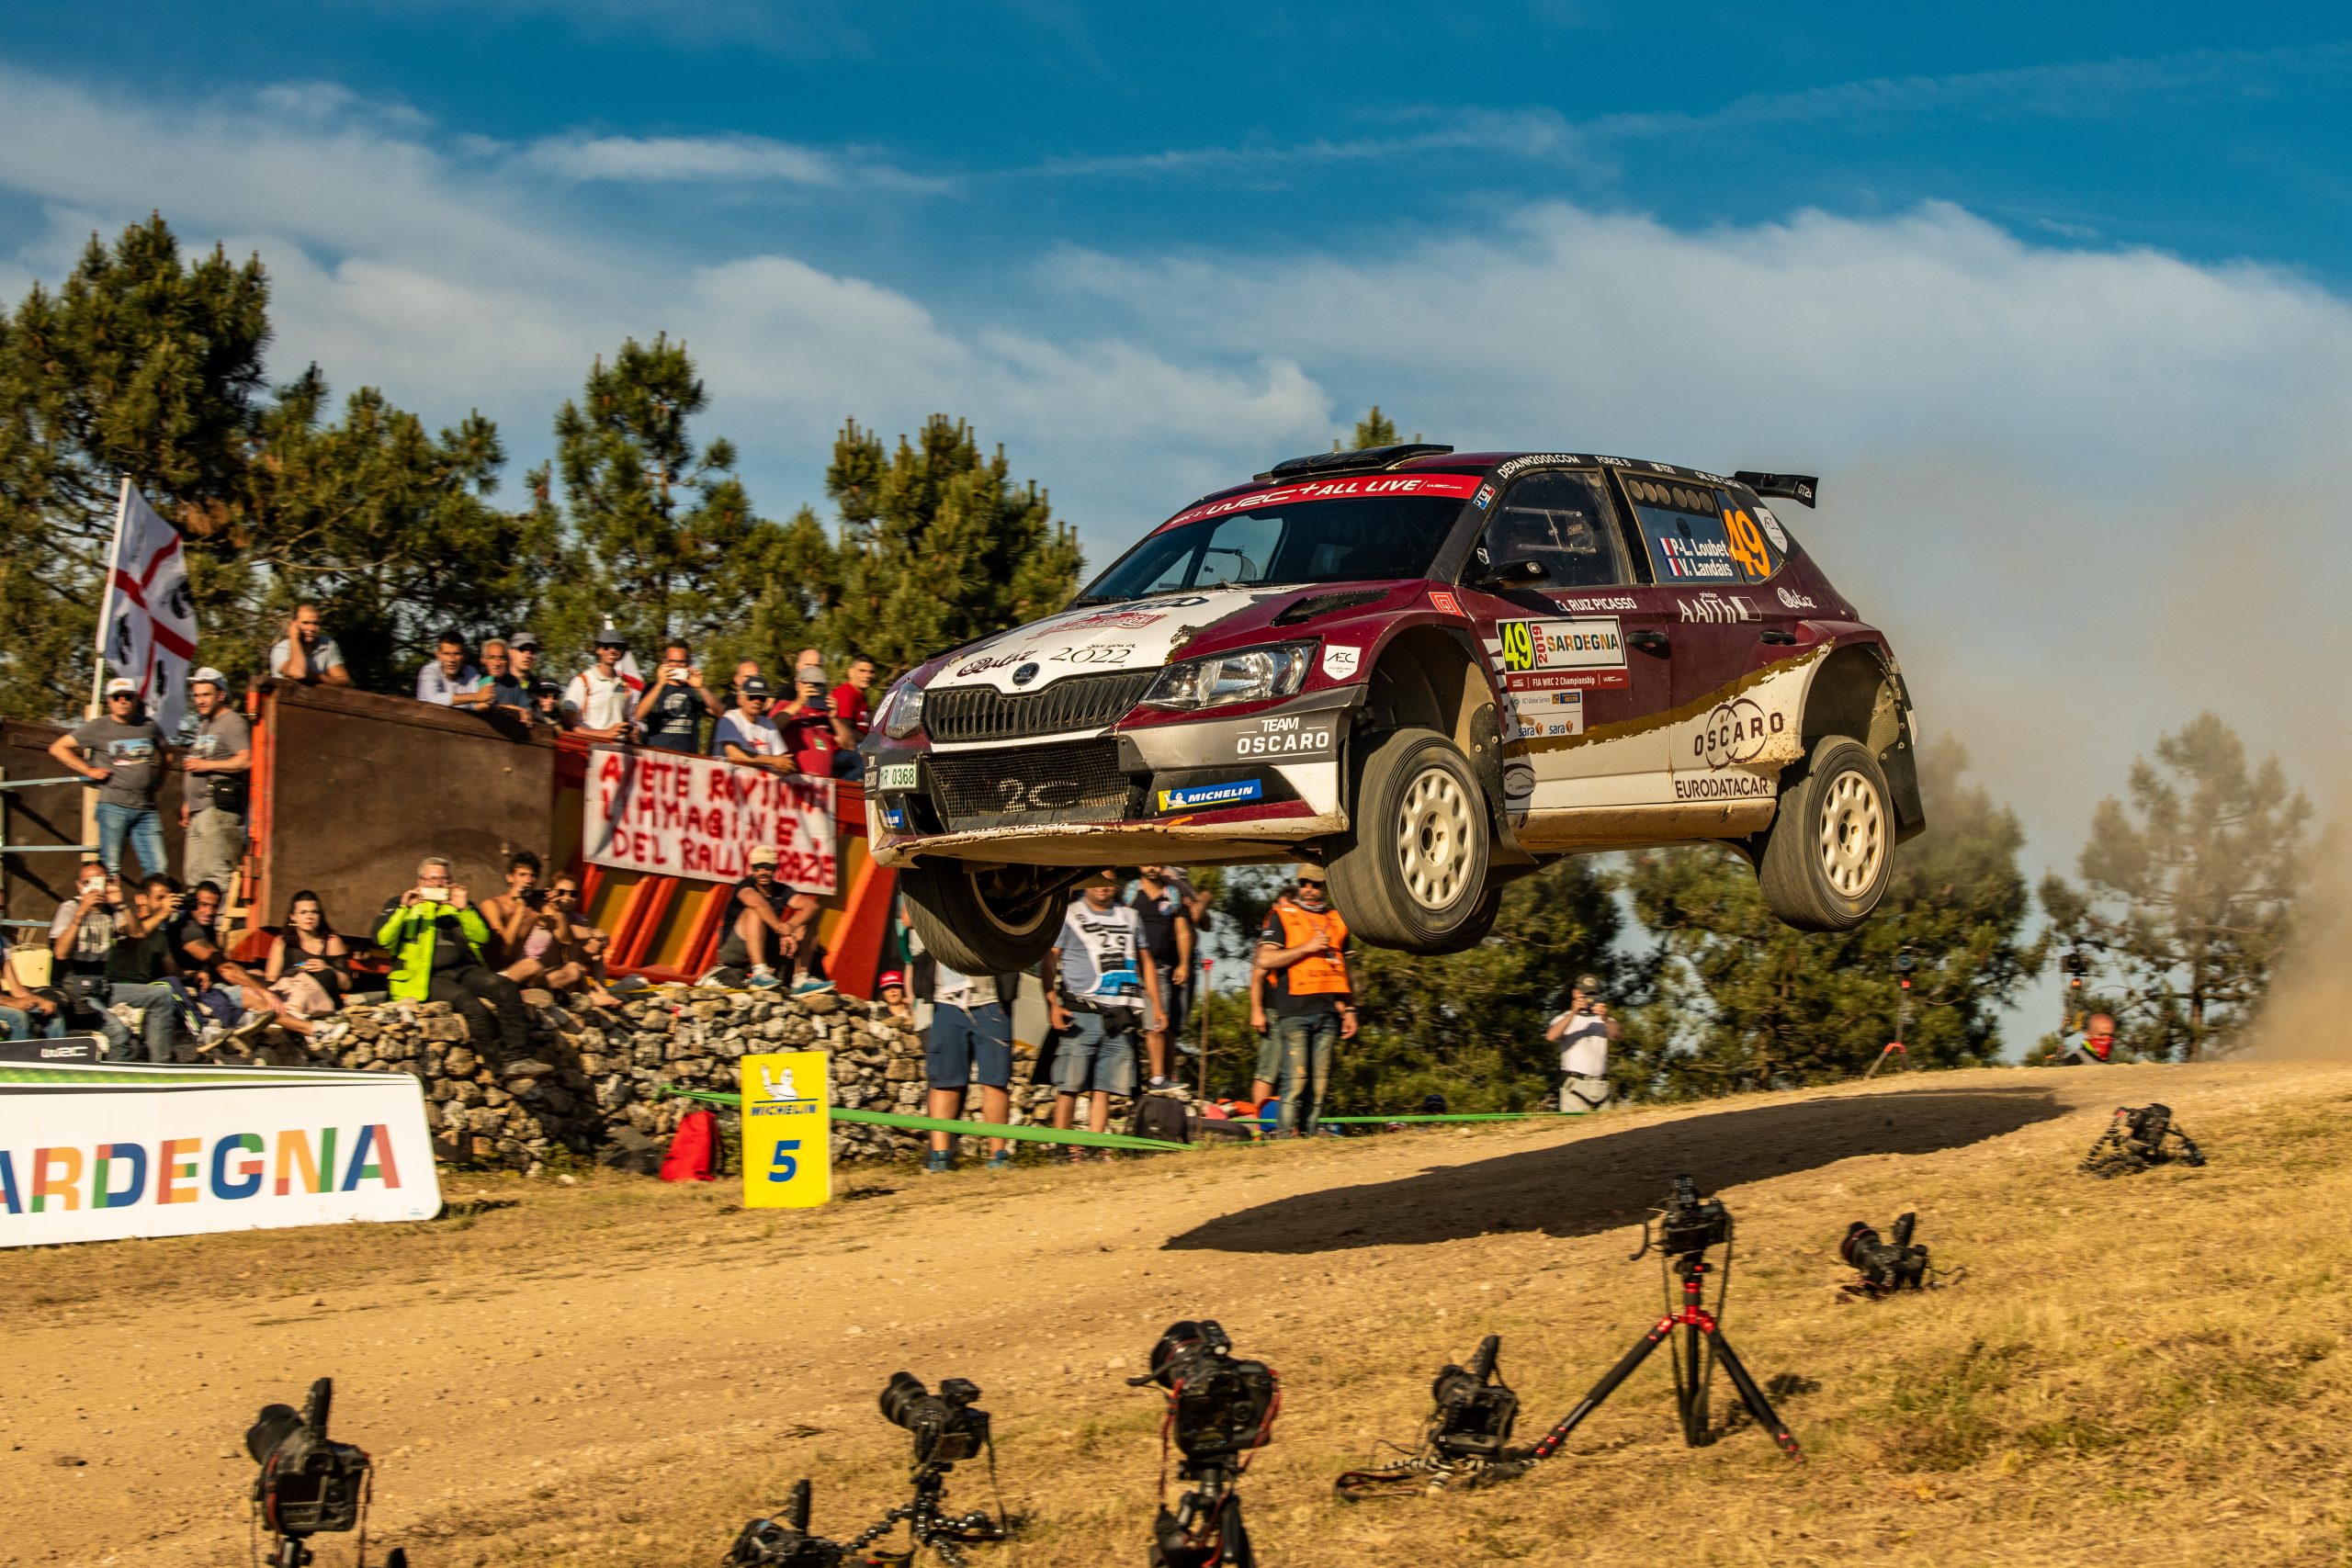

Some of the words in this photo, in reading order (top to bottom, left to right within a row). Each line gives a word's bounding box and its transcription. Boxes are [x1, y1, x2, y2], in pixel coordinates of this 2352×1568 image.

[1497, 454, 1580, 479] DEPANN2000.COM
[1314, 482, 1358, 496] ALL
[1364, 479, 1422, 492] LIVE
[1797, 483, 1813, 499] GT2i
[1690, 538, 1730, 558] Loubet
[1724, 508, 1770, 577] 49
[1678, 558, 1693, 577] V.
[1690, 558, 1734, 577] Landais
[1566, 598, 1595, 612] RUIZ
[1591, 597, 1638, 610] PICASSO
[1504, 622, 1532, 671] 49
[1532, 626, 1548, 664] 2019
[1545, 633, 1621, 652] SARDEGNA
[1049, 647, 1131, 664] 2022
[1532, 677, 1542, 687] FIA
[1543, 677, 1555, 687] WRC
[1555, 677, 1559, 686] 2
[1560, 674, 1596, 687] Championship
[1261, 716, 1300, 733] TEAM
[1519, 727, 1535, 737] sara
[1549, 724, 1566, 735] sara
[1237, 731, 1329, 754] OSCARO
[1693, 711, 1784, 758] OSCARO
[891, 767, 915, 785] 0368
[1187, 785, 1253, 803] MICHELIN
[1675, 776, 1770, 799] EURODATACAR
[612, 827, 667, 865] DEL
[776, 838, 837, 888] RAZIE
[749, 1103, 817, 1117] MICHELIN
[767, 1139, 801, 1183] 5
